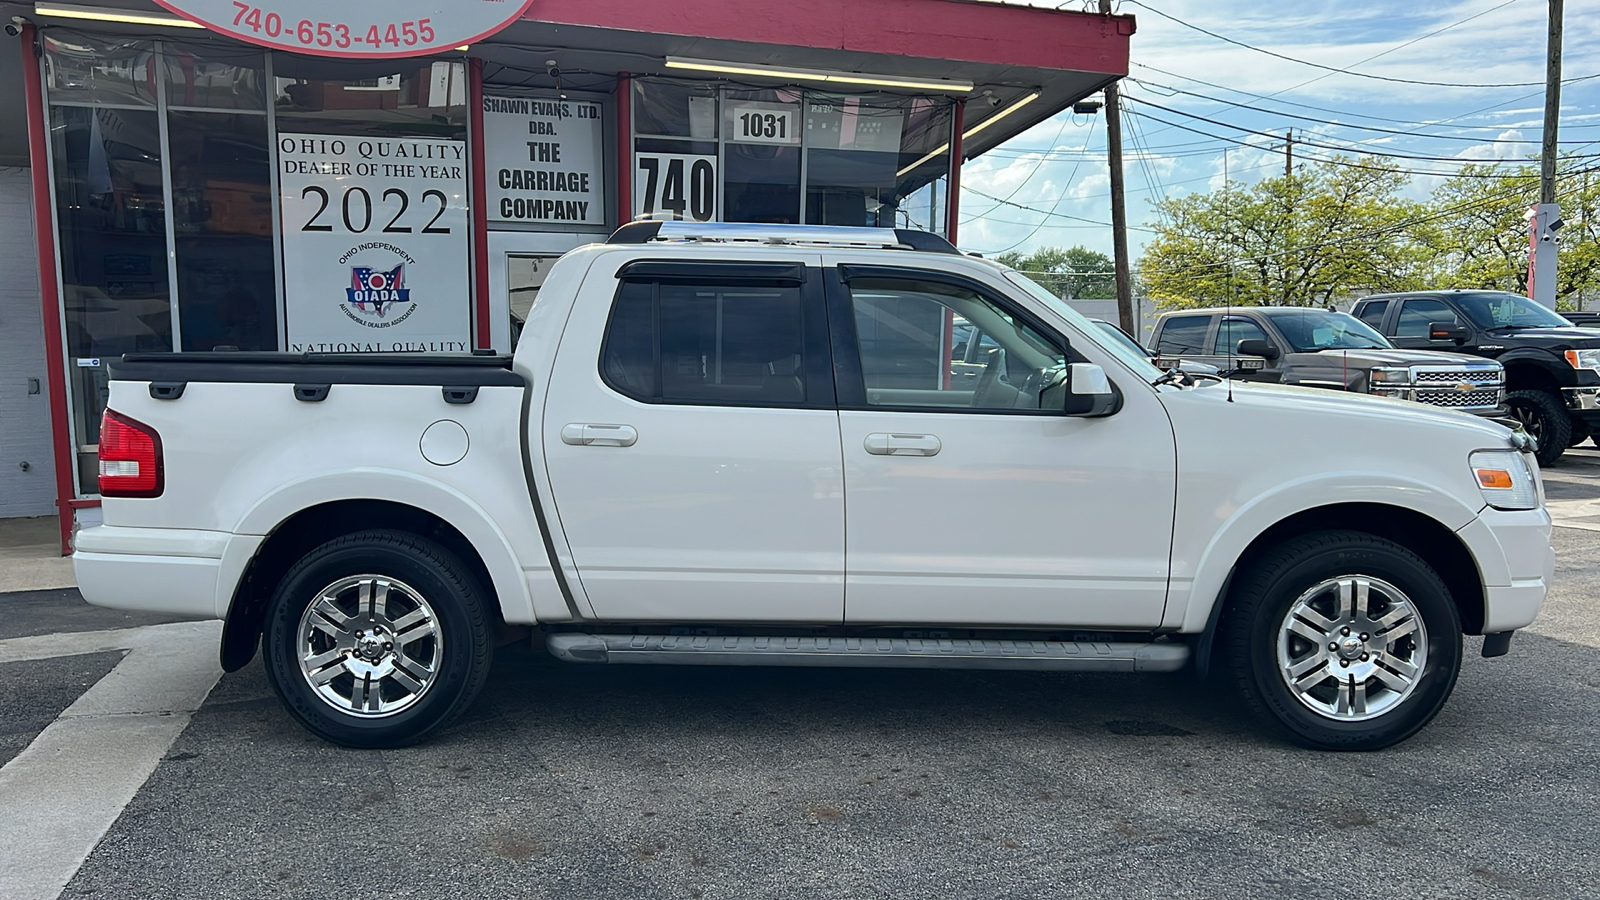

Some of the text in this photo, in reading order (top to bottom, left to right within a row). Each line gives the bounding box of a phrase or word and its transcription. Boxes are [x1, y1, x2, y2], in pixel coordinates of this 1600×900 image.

[232, 1, 435, 48] 740-653-4455
[483, 98, 528, 114] SHAWN
[577, 105, 600, 119] LTD.
[529, 121, 557, 135] DBA.
[740, 113, 786, 138] 1031
[281, 138, 464, 159] OHIO QUALITY
[527, 142, 561, 163] THE
[285, 160, 462, 179] DEALER OF THE YEAR
[498, 168, 589, 193] CARRIAGE
[639, 157, 714, 222] 740
[301, 185, 451, 234] 2022
[500, 198, 589, 221] COMPANY
[339, 242, 416, 265] OHIO INDEPENDENT
[354, 290, 400, 302] OIADA
[339, 302, 418, 329] AUTOMOBILE DEALERS ASSOCIATION
[292, 341, 467, 352] NATIONAL QUALITY
